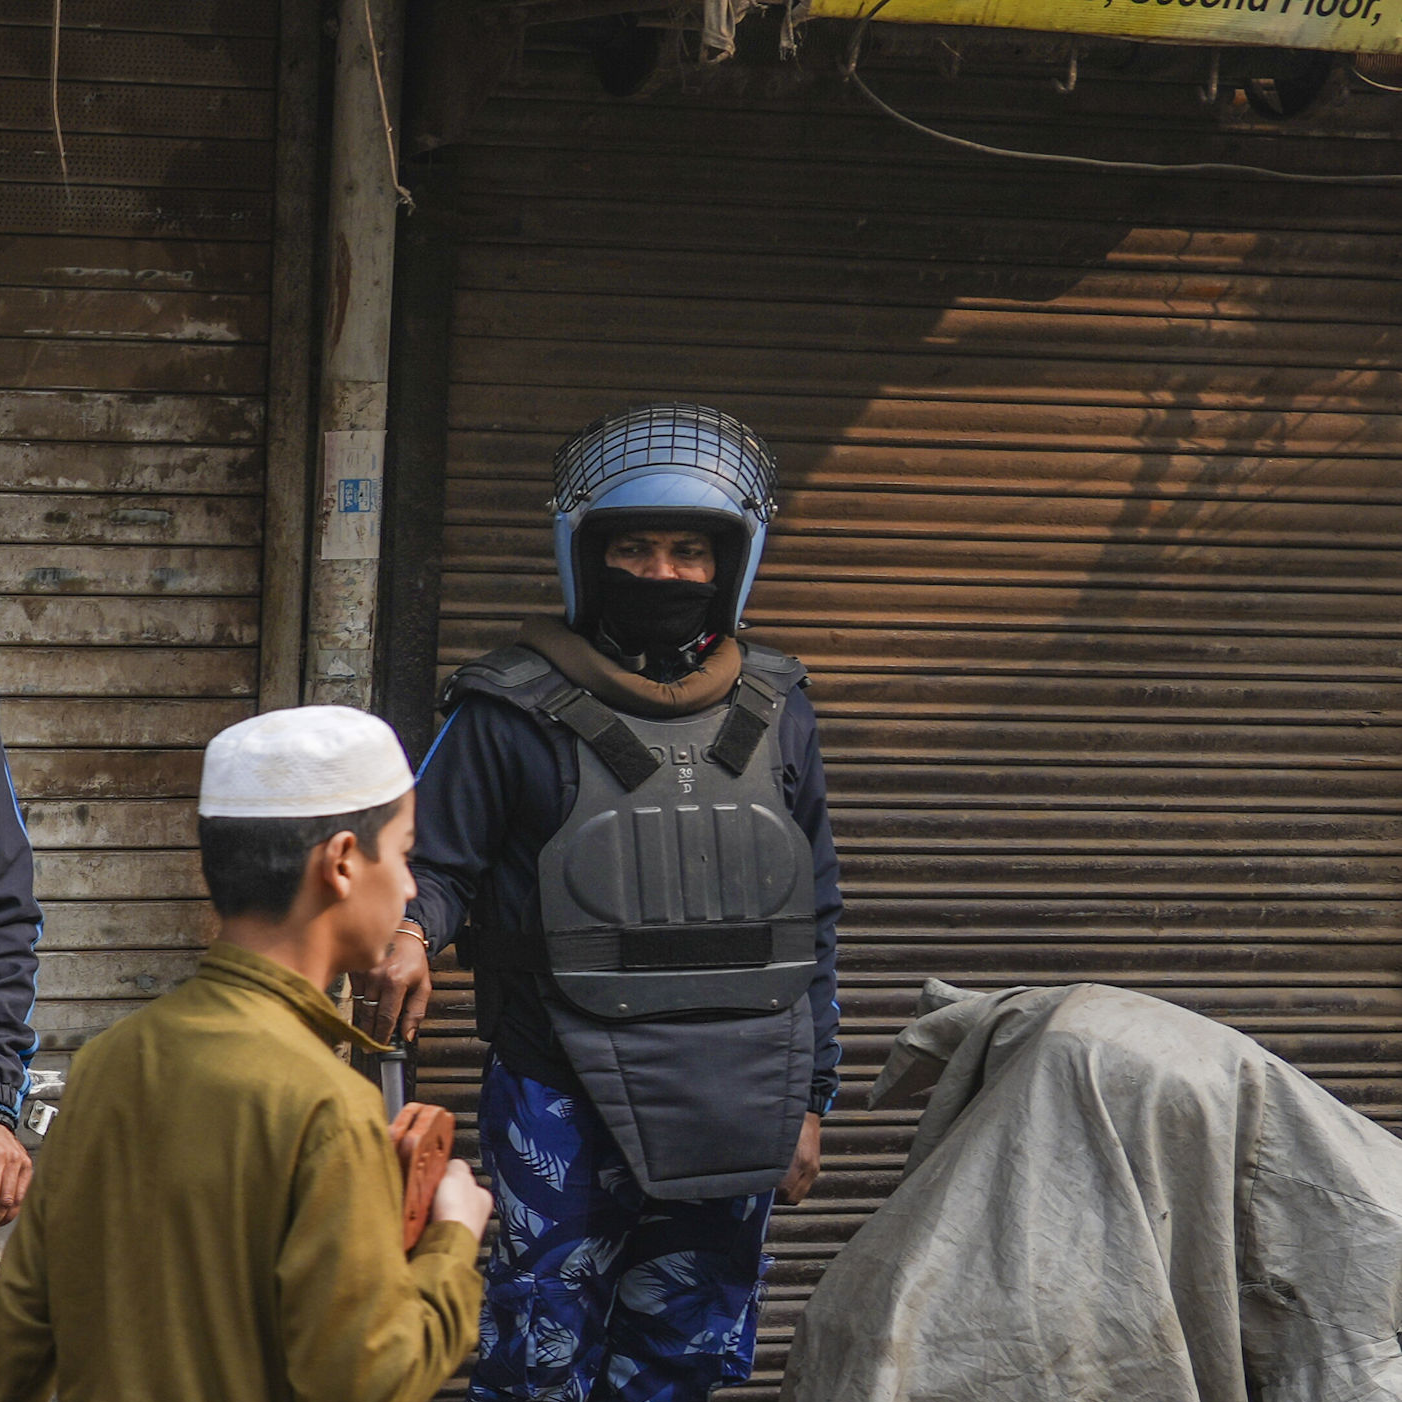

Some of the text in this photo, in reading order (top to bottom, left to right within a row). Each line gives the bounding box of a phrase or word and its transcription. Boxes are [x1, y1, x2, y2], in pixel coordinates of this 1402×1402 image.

[648, 744, 717, 766] OLIC
[678, 768, 693, 779] 39
[683, 783, 692, 793] D
